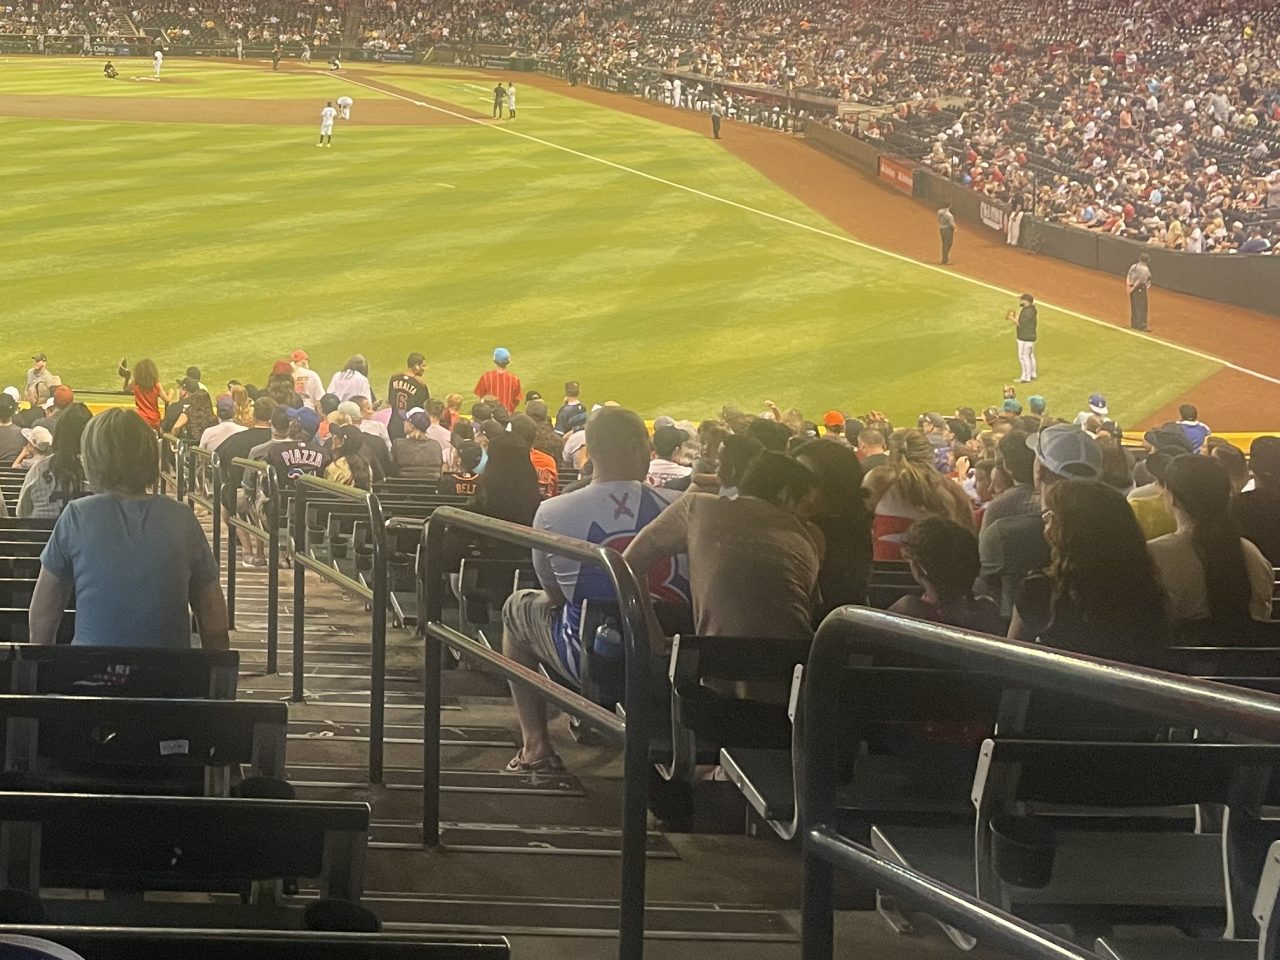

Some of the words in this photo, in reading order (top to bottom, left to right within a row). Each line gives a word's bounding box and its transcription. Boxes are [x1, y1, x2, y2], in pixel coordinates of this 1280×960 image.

[393, 380, 417, 395] PERALTA
[396, 391, 408, 410] 6
[281, 449, 323, 468] PIAZZA
[456, 483, 477, 494] BELT
